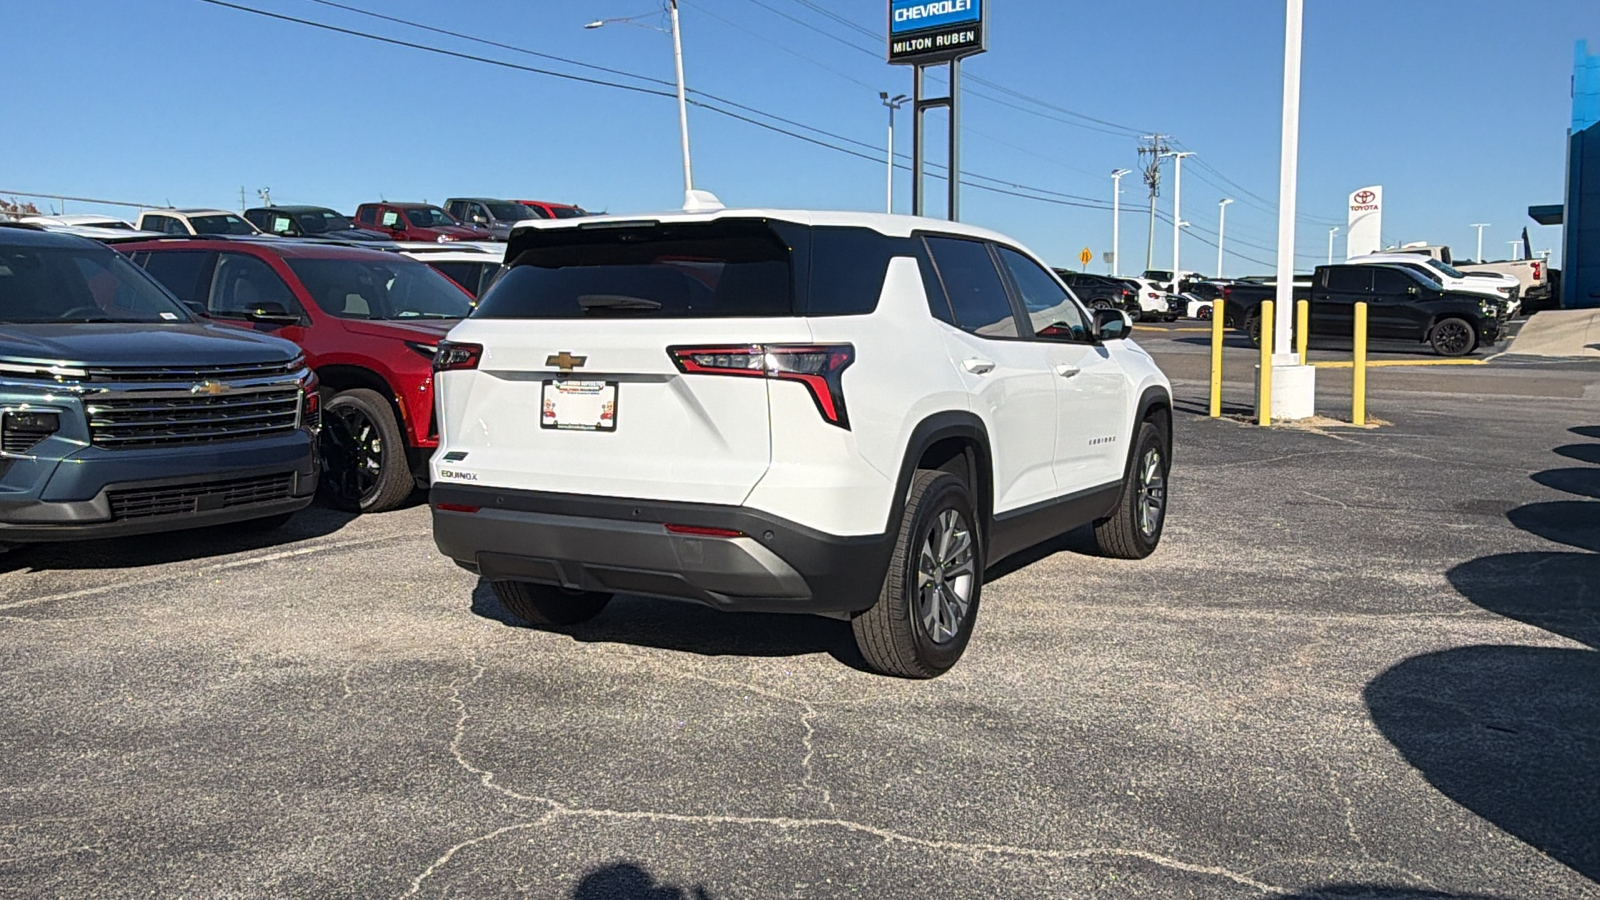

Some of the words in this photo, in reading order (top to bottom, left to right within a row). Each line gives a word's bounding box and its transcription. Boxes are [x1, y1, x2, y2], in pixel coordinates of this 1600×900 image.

[895, 0, 971, 22] CHEVROLET
[893, 37, 932, 54] MILTON
[936, 31, 974, 47] RUBEN
[441, 470, 478, 481] EQUINOX
